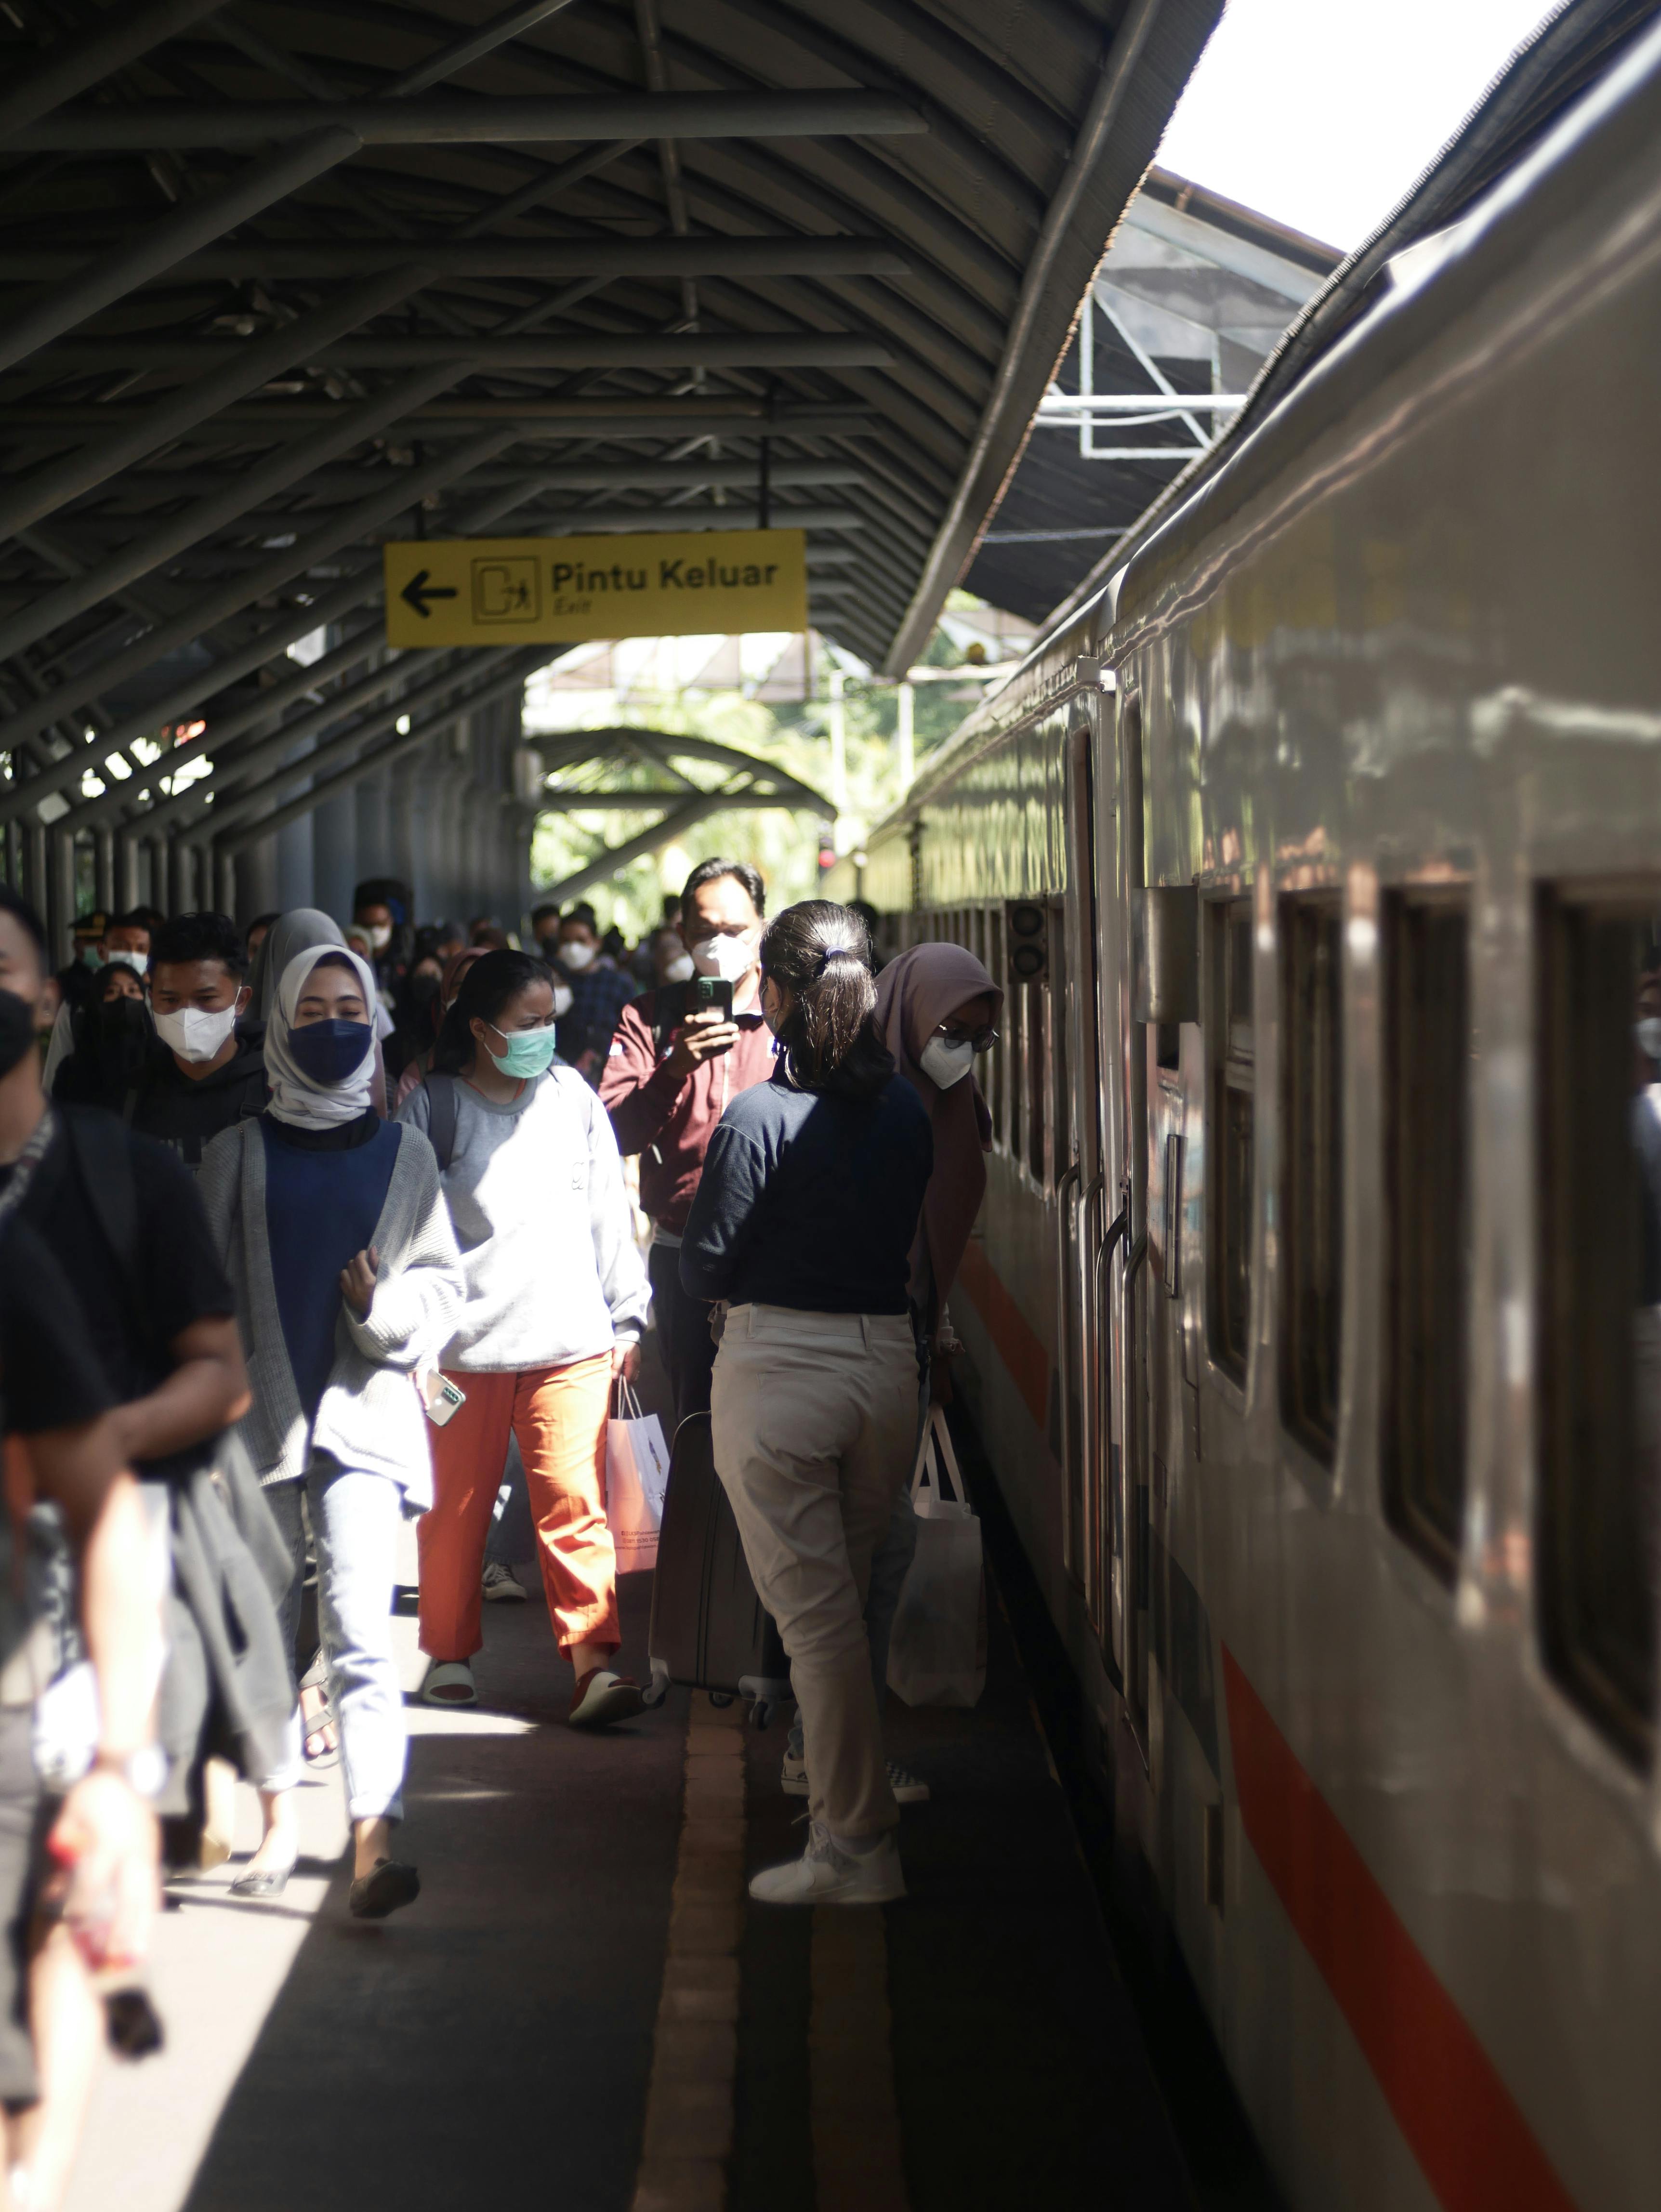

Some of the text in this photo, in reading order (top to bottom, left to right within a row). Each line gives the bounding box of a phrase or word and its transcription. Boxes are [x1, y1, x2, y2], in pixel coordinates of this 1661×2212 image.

[552, 556, 778, 593] Pintu Keluar
[554, 596, 592, 616] Exit
